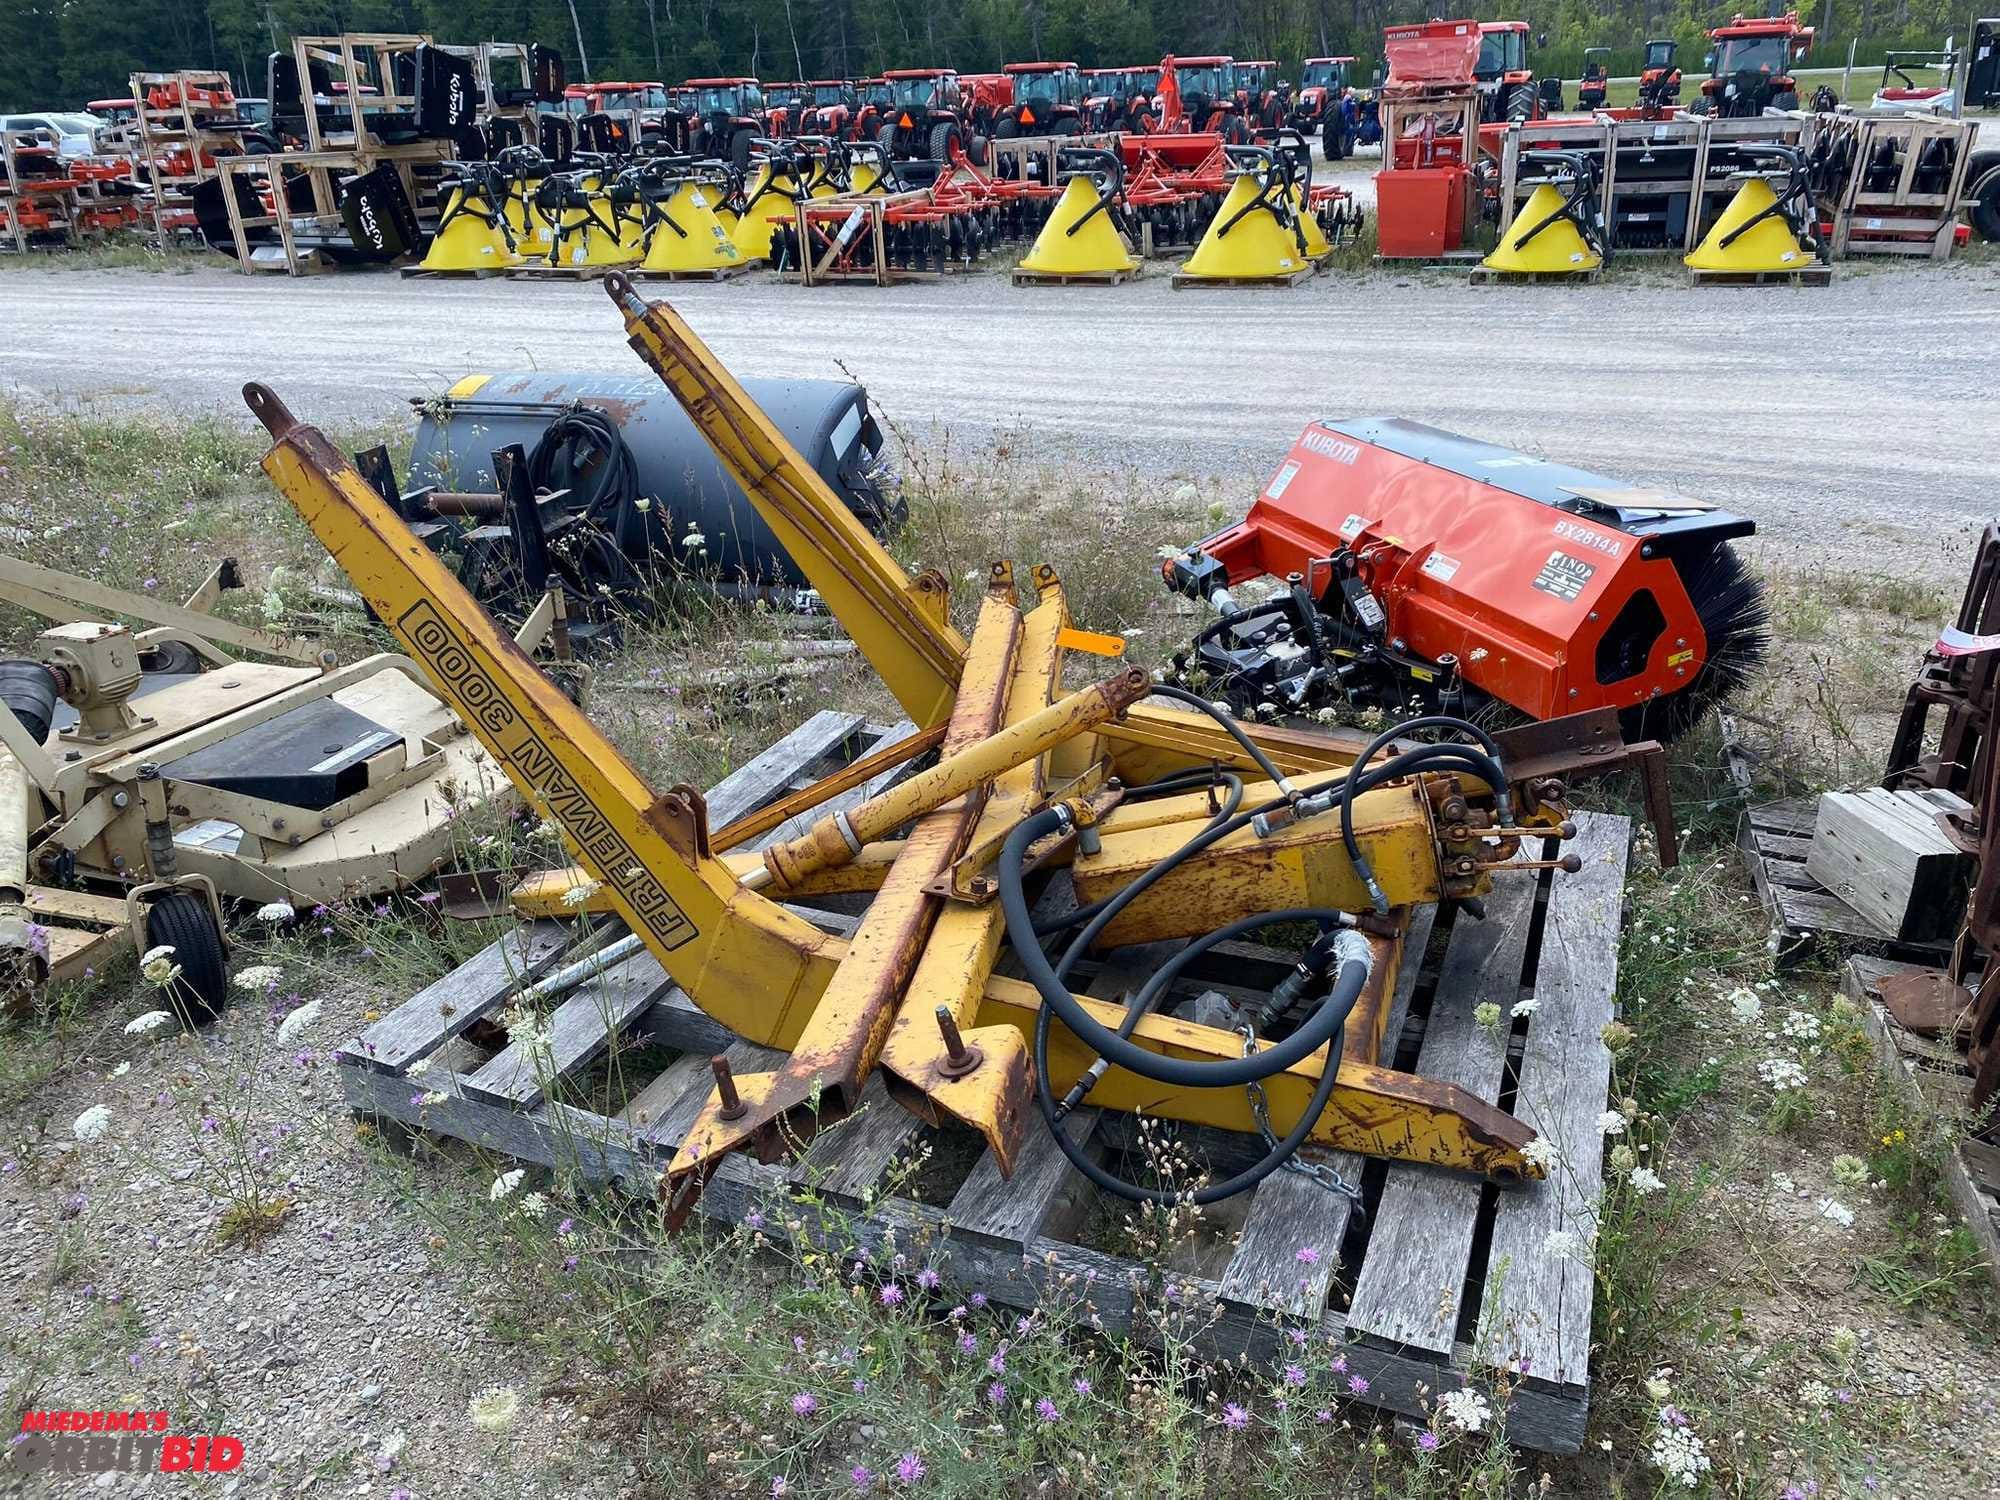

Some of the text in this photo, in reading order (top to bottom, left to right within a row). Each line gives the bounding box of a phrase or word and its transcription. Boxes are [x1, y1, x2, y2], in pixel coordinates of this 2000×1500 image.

[449, 73, 461, 125] Kubota
[360, 195, 384, 250] Kubota
[1301, 431, 1361, 465] KUBOTA
[1553, 520, 1621, 556] BX2814A
[414, 620, 686, 938] FREEMAN 3000
